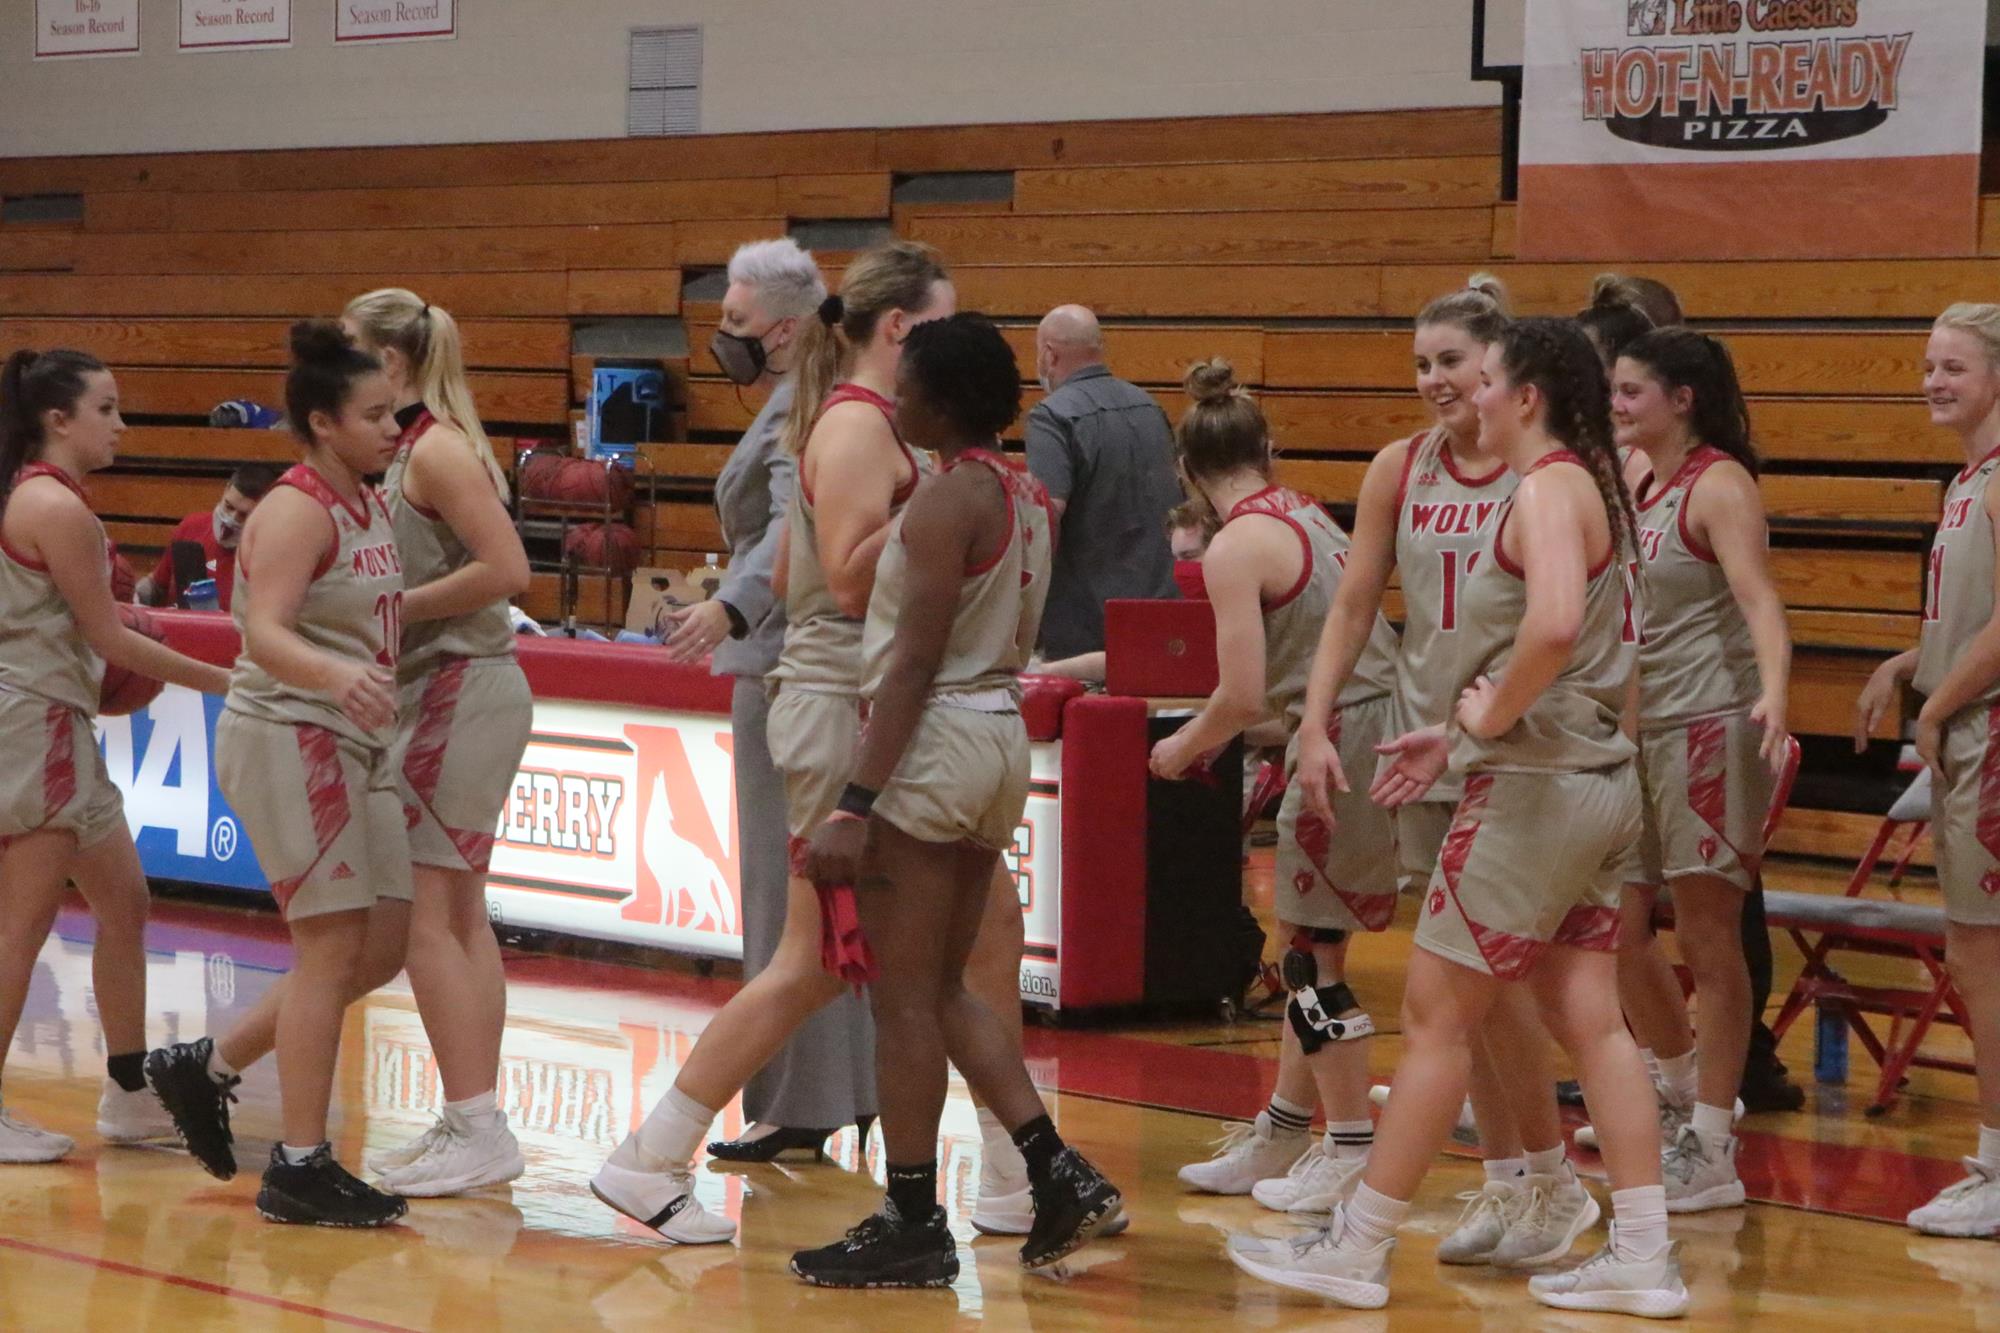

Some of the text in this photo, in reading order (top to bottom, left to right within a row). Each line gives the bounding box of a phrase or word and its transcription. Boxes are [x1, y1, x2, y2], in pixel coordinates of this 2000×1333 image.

[50, 16, 125, 36] Season Record
[194, 6, 275, 27] Season Record
[349, 0, 439, 25] Season Record
[1671, 0, 1858, 35] Little Caesars
[1580, 32, 1912, 120] HOT-N-READY
[1682, 119, 1809, 141] PIZZA
[1410, 501, 1503, 540] WOLV
[1438, 549, 1483, 632] 1
[496, 770, 623, 857] ERRY
